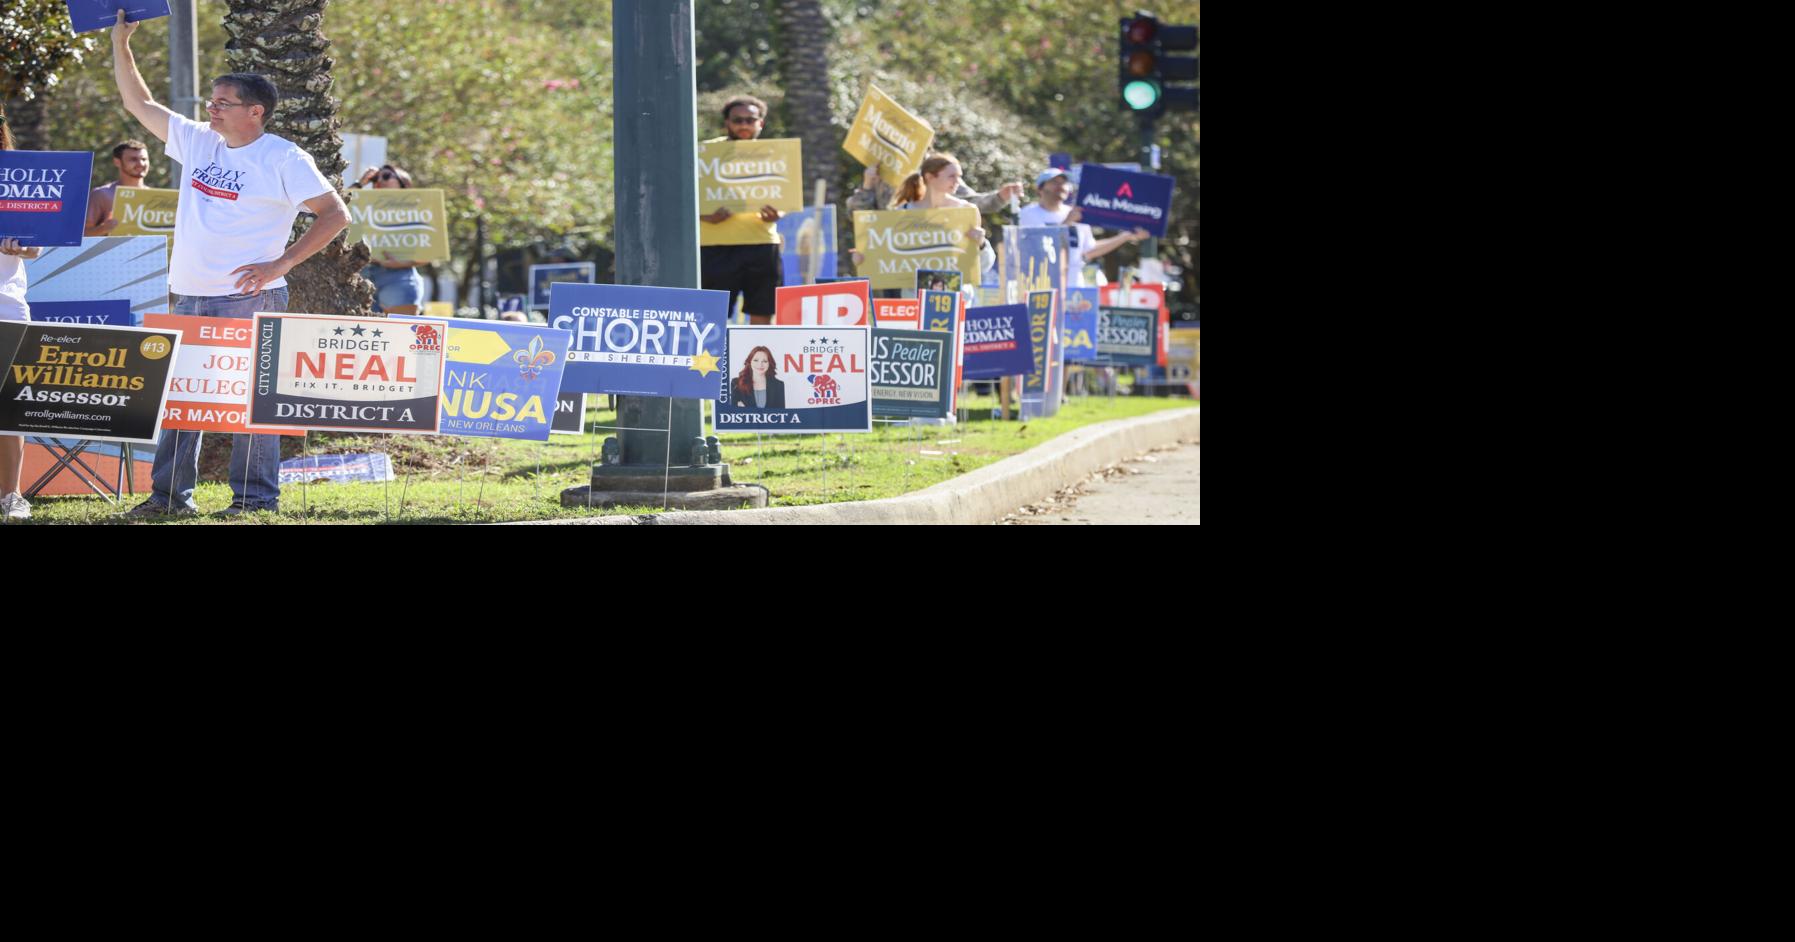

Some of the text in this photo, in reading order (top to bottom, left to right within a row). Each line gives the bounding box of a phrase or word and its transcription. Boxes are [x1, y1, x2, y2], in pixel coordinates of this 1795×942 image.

[0, 168, 67, 182] HOLLY
[699, 157, 787, 179] Moreno
[706, 184, 783, 200] MAYOR
[351, 204, 433, 225] Moreno
[867, 227, 963, 250] Moreno
[879, 256, 959, 273] MAYOR
[572, 306, 697, 322] CONSTABLE EDWIN M.
[966, 316, 1014, 331] HOLLY
[40, 334, 82, 344] Re-elect
[552, 314, 715, 355] SHORTY
[143, 342, 164, 353] #13
[318, 338, 390, 352] BRIDGET
[802, 345, 845, 354] BRIDGET
[892, 343, 937, 362] Pealer
[36, 345, 128, 368] Erroll
[203, 355, 249, 371] JOE
[258, 322, 274, 396] CITY COUNCIL
[608, 353, 692, 366] SHERIFF
[784, 353, 865, 374] NEAL
[294, 351, 417, 383] NEAL
[11, 365, 145, 391] Williams
[294, 381, 318, 389] FIX
[353, 384, 414, 393] BRIDGET
[13, 386, 131, 407] Assessor
[807, 397, 841, 405] OPREC
[24, 409, 111, 421] errollgwilliams.com
[275, 403, 416, 423] DISTRICT A
[719, 413, 801, 424] DISTRICT A
[448, 420, 474, 429] NEW
[475, 421, 526, 433] ORLEANS
